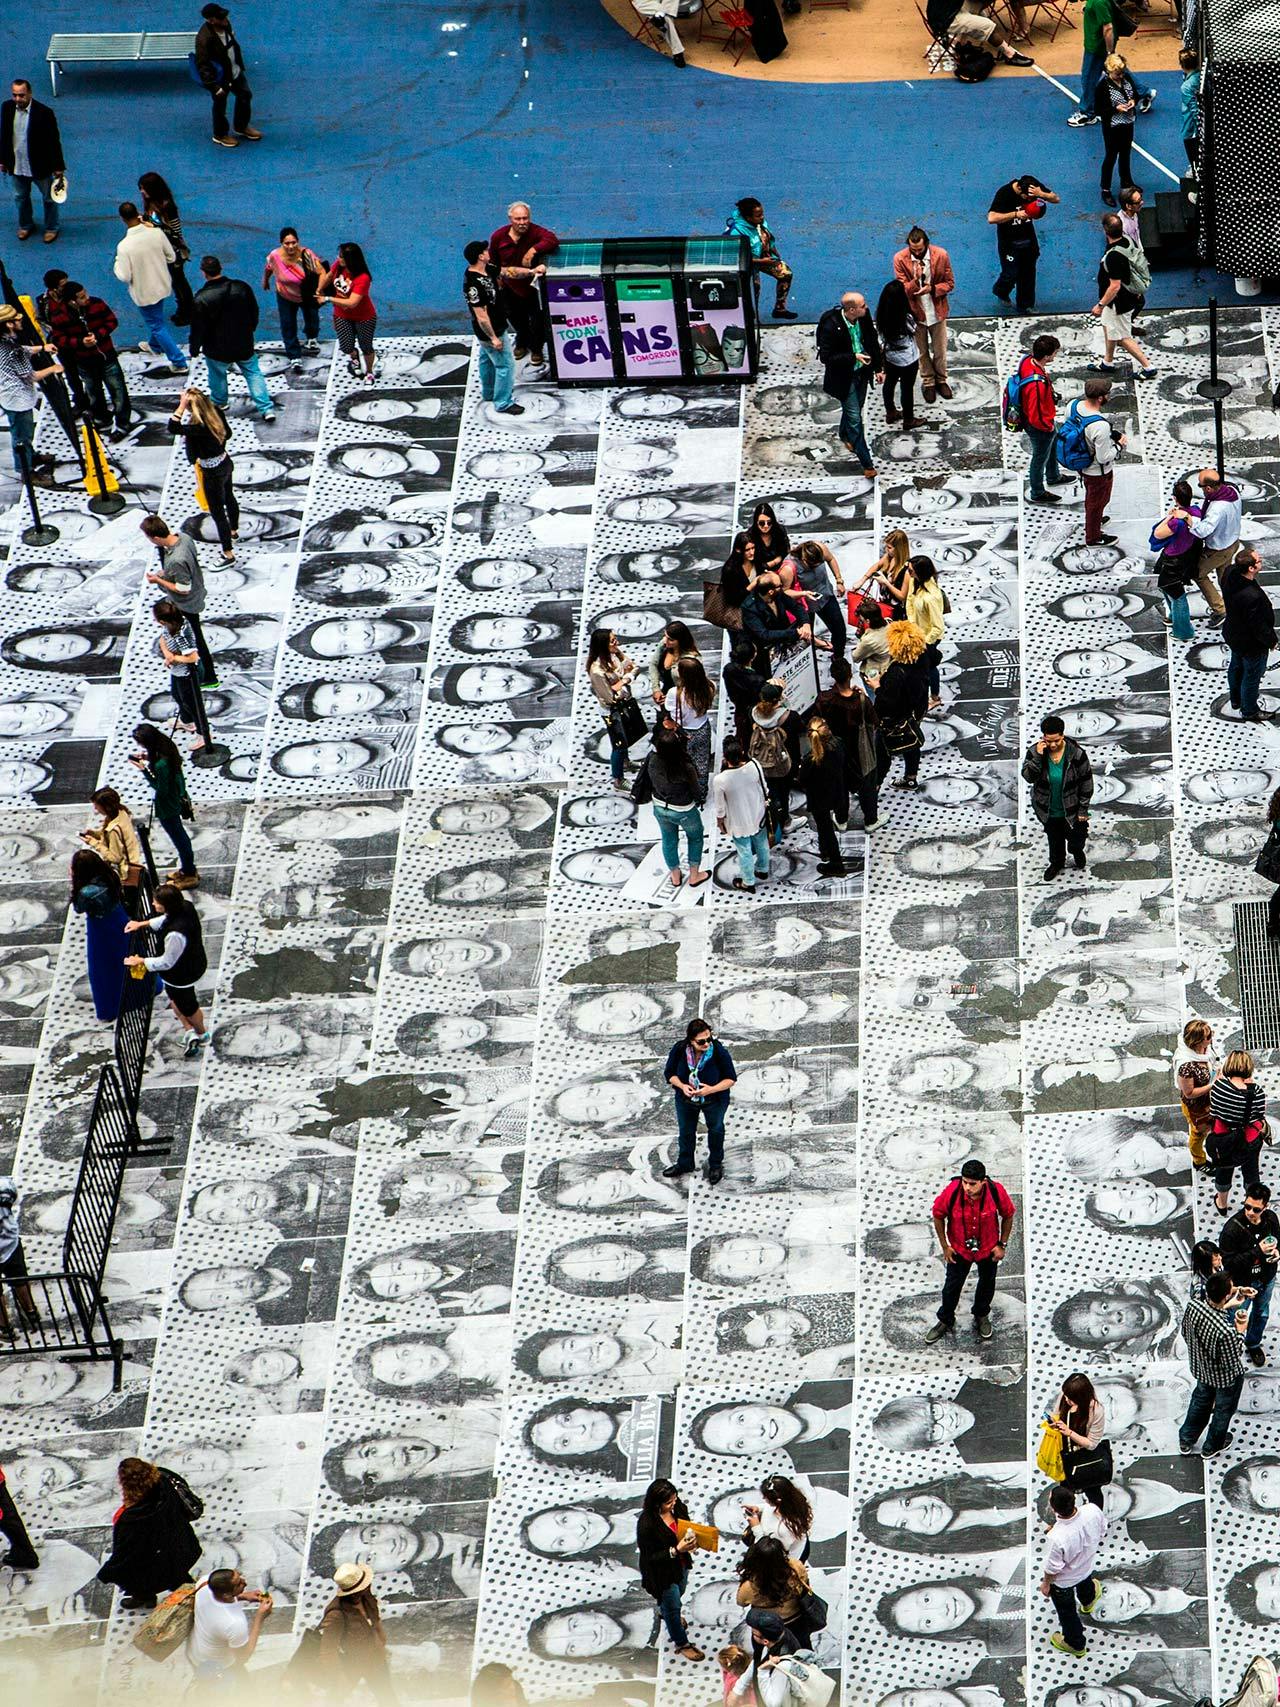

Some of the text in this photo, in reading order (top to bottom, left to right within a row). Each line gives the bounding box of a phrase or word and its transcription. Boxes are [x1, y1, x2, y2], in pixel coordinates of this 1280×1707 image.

[566, 315, 599, 328] CANS
[557, 325, 597, 341] TODAY
[631, 350, 678, 363] TOMORROW
[795, 652, 810, 669] HERE
[977, 703, 1010, 731] FROM
[631, 1436, 655, 1481] JULIA
